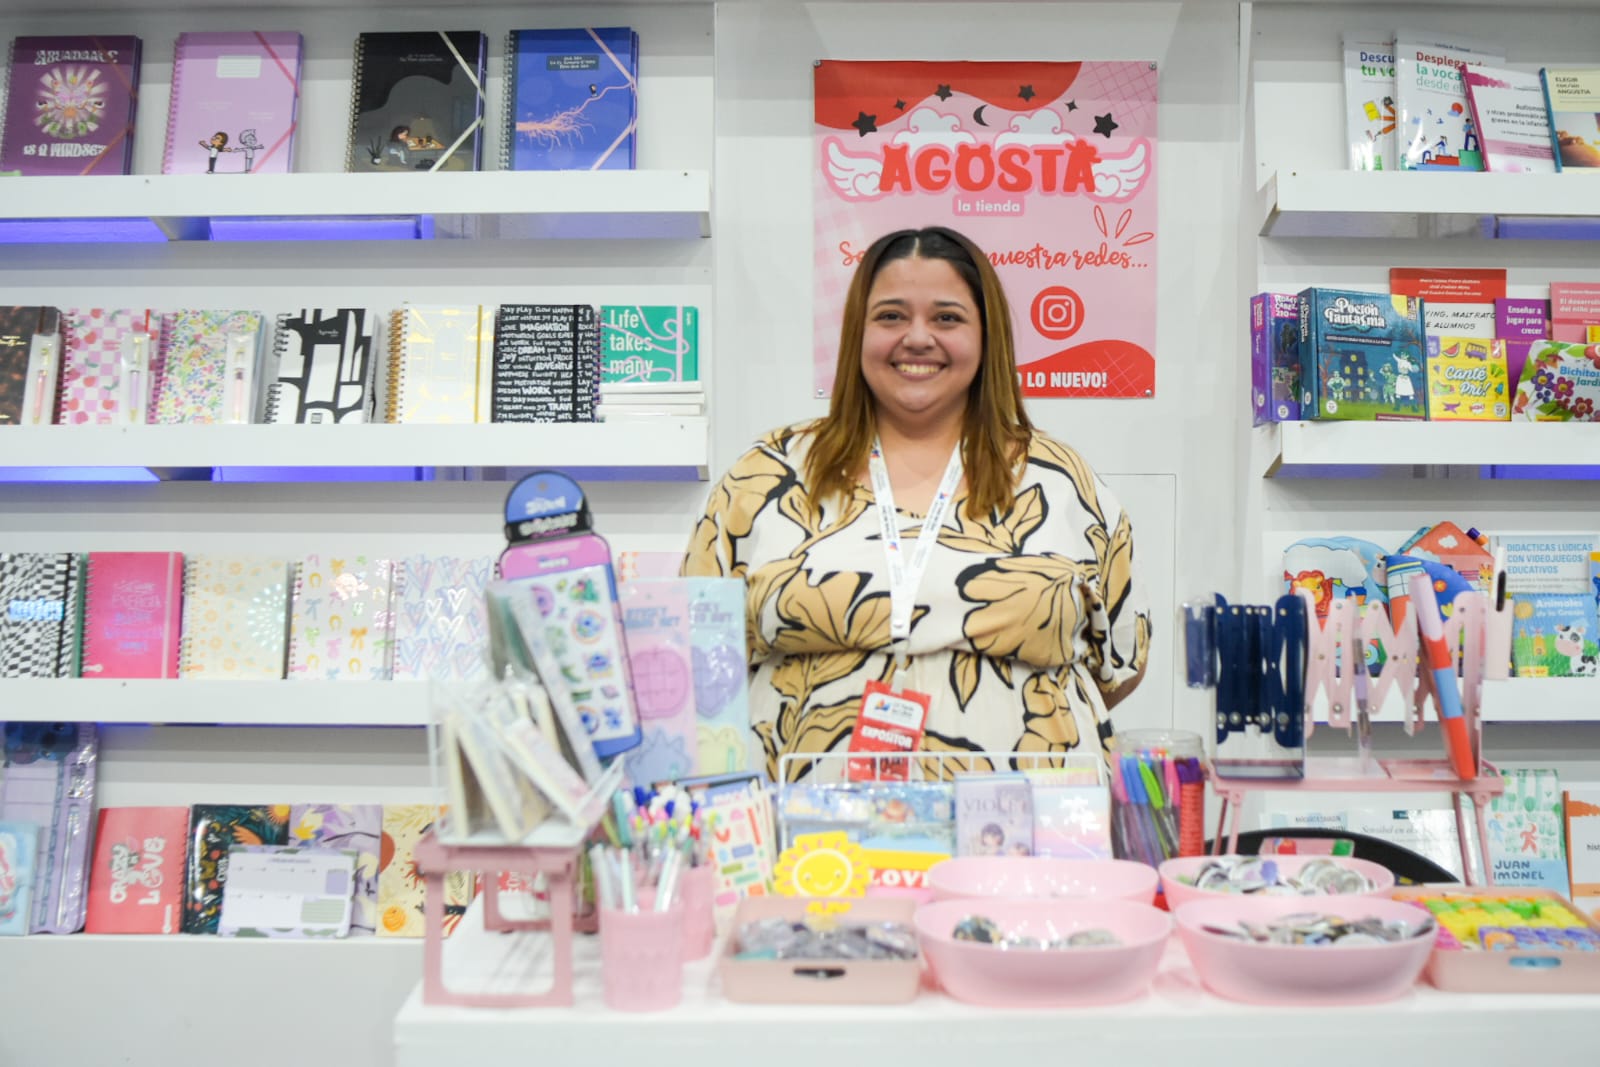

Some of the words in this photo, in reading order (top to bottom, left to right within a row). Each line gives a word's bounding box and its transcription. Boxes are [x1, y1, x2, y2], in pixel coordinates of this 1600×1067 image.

[1361, 64, 1376, 77] tu
[1416, 62, 1428, 76] la
[1416, 75, 1449, 91] desde
[879, 138, 1104, 193] AGOSTA
[958, 200, 971, 212] la
[976, 199, 1021, 213] tienda
[1426, 310, 1449, 318] YING,
[1507, 305, 1536, 315] Enseñar
[1537, 307, 1542, 315] a
[1433, 322, 1476, 330] ALUMNOS
[1521, 327, 1542, 335] crecer
[609, 333, 653, 352] takes
[609, 359, 654, 379] many
[1445, 365, 1487, 381] Canté
[1027, 371, 1046, 388] LO
[1050, 371, 1108, 388] NUEVO!
[1507, 554, 1525, 563] CON
[1526, 554, 1584, 563] VIDEOJUEGOS
[1507, 565, 1559, 574] EDUCATIVOS
[861, 725, 913, 749] EXPOSITOR
[1495, 860, 1530, 870] JUAN
